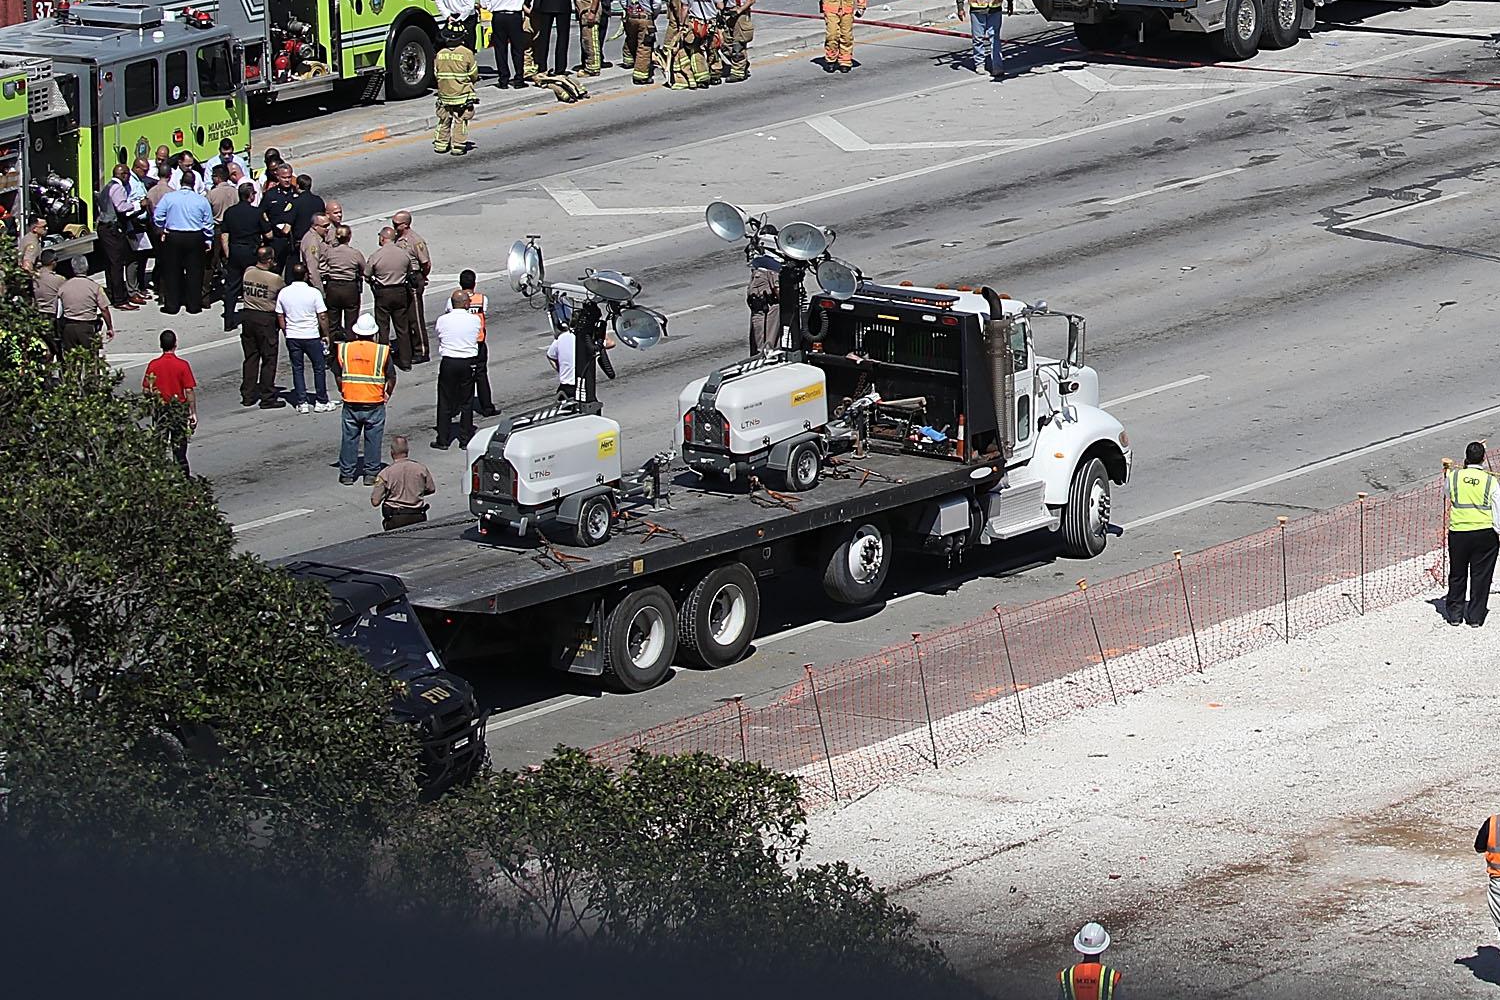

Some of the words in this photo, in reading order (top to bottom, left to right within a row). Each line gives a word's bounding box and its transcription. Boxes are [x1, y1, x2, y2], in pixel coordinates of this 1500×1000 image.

[35, 1, 52, 20] 37
[208, 118, 239, 132] MIAMI-DADE
[208, 132, 219, 142] FIRE
[220, 126, 239, 139] RESCUE
[244, 286, 268, 299] POLICE
[600, 440, 614, 449] Herc
[1463, 476, 1480, 486] cap
[420, 686, 451, 704] FIU
